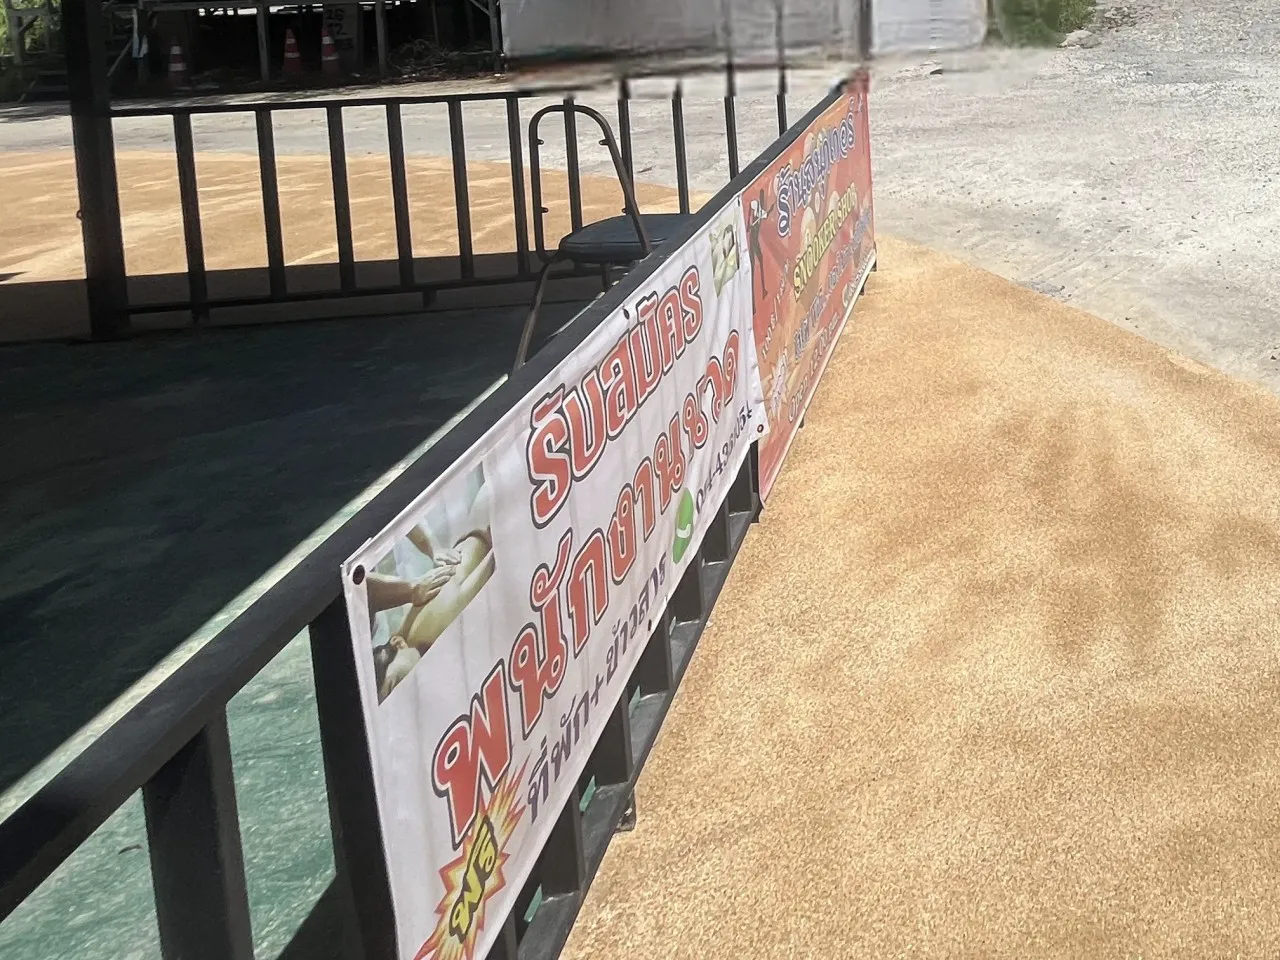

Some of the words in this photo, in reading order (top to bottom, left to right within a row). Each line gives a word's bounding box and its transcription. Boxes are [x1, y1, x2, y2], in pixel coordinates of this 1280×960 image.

[794, 209, 836, 301] SNOOKER
[527, 264, 703, 529] รับสมัคร
[788, 374, 808, 423] Open
[432, 329, 741, 850] พนักงานนวด
[525, 554, 669, 825] ที่พัก+ข้าวสาร
[449, 814, 499, 943] ฟรี
